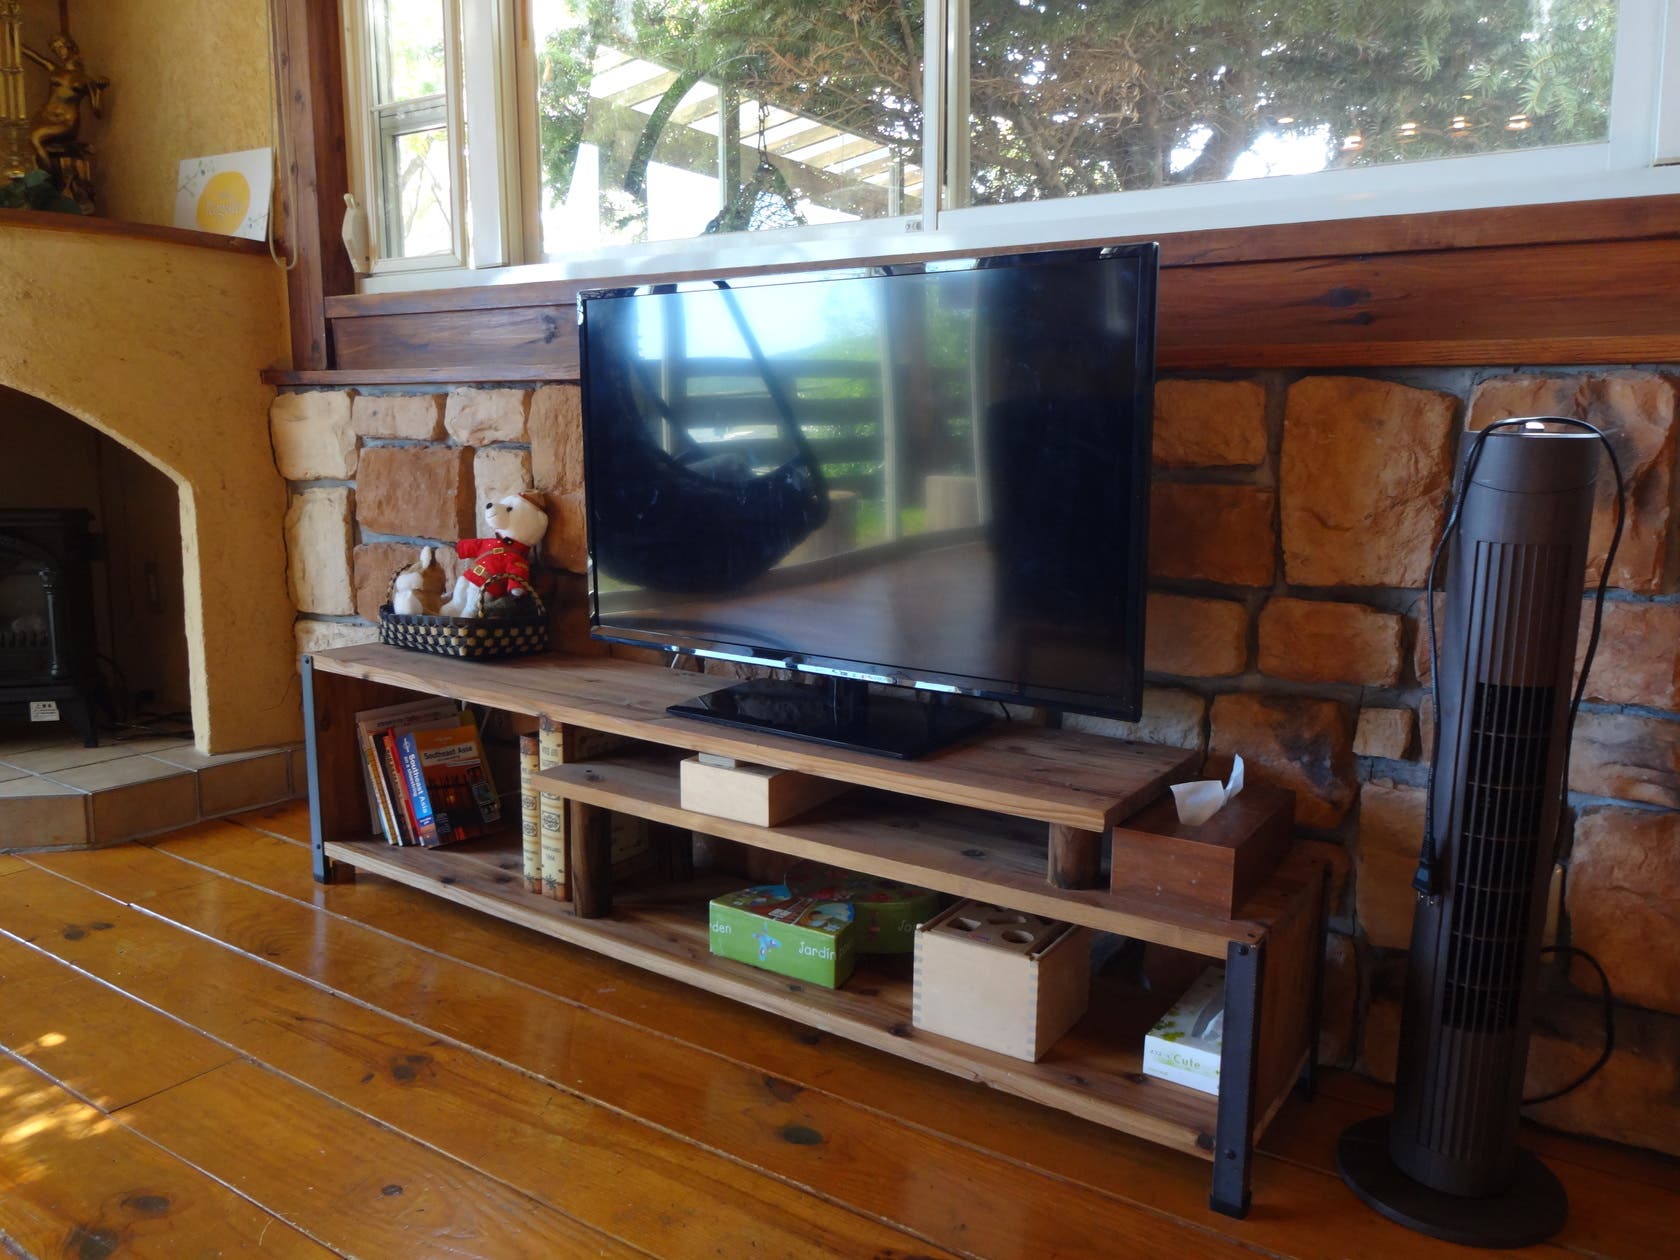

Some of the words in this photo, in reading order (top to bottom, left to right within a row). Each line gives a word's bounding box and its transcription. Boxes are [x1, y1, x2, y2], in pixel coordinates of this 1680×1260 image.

[409, 753, 424, 795] Southeast
[419, 796, 428, 814] Asia
[709, 919, 732, 935] den
[1173, 1054, 1201, 1069] Cute
